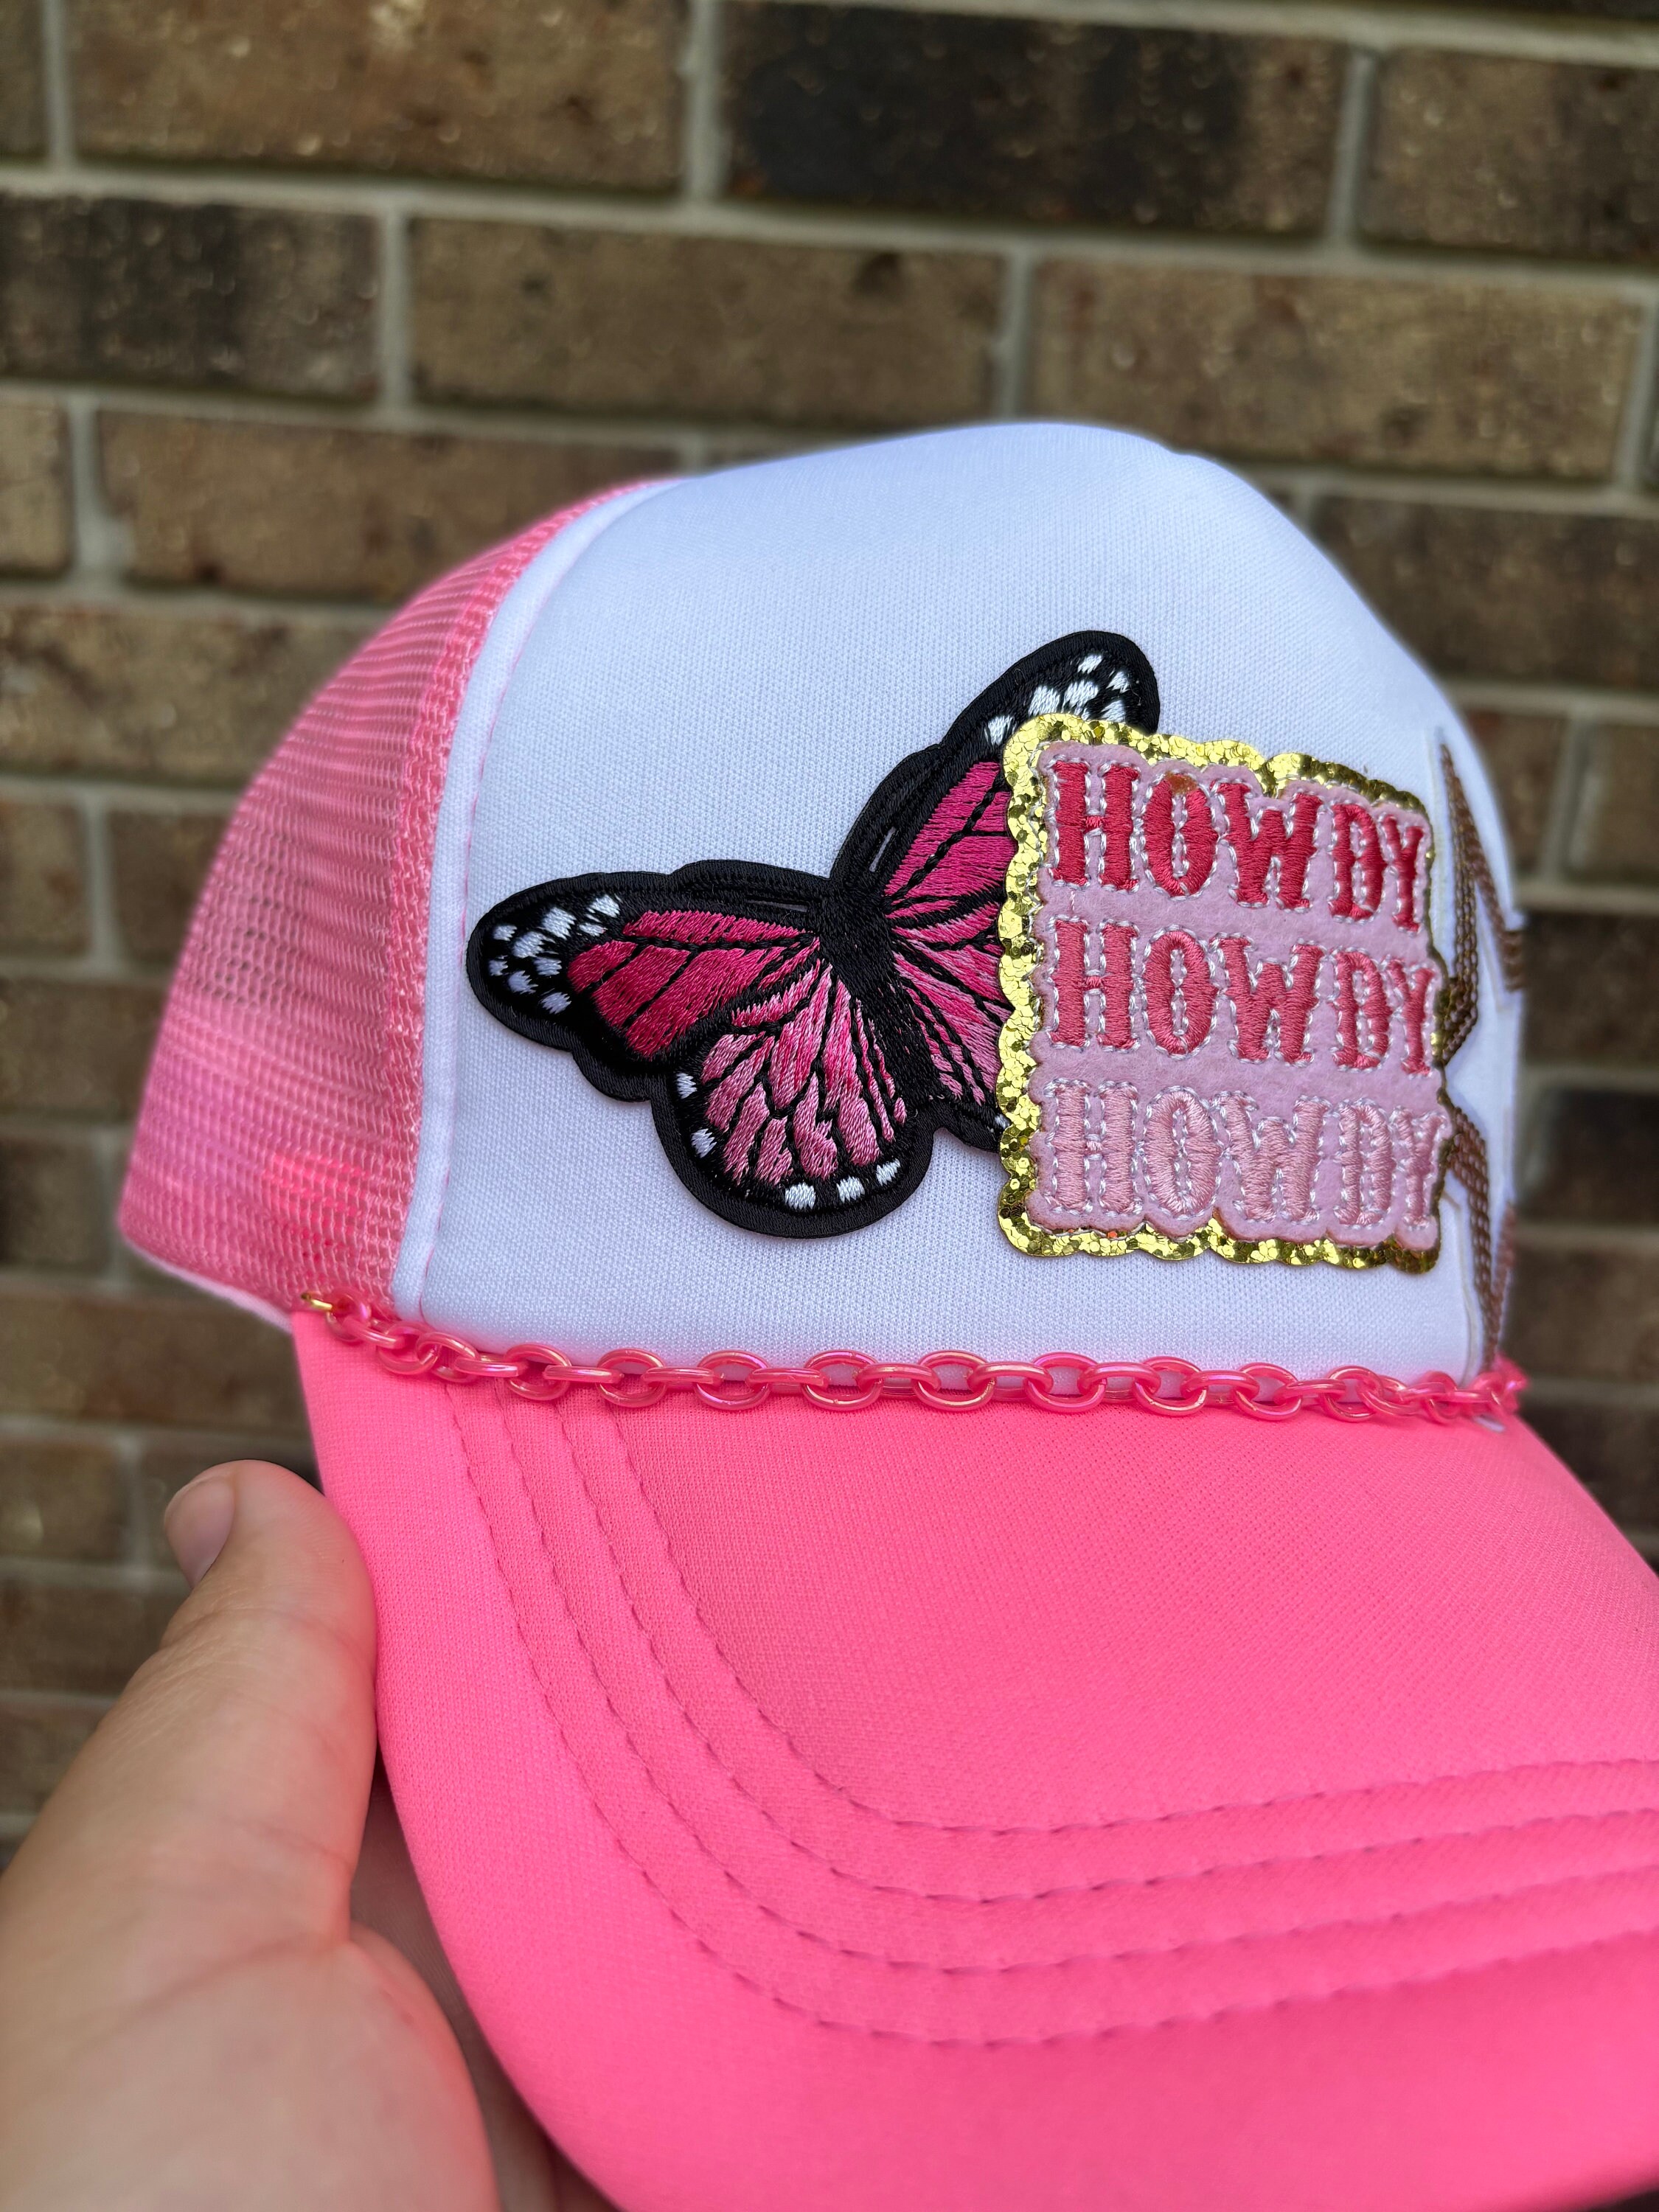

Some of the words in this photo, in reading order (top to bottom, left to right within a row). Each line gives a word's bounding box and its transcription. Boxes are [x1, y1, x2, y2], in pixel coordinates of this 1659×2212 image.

[1046, 759, 1425, 933] HOWDY
[1046, 917, 1438, 1078] HOWDY
[1044, 1079, 1444, 1229] HOWDY
